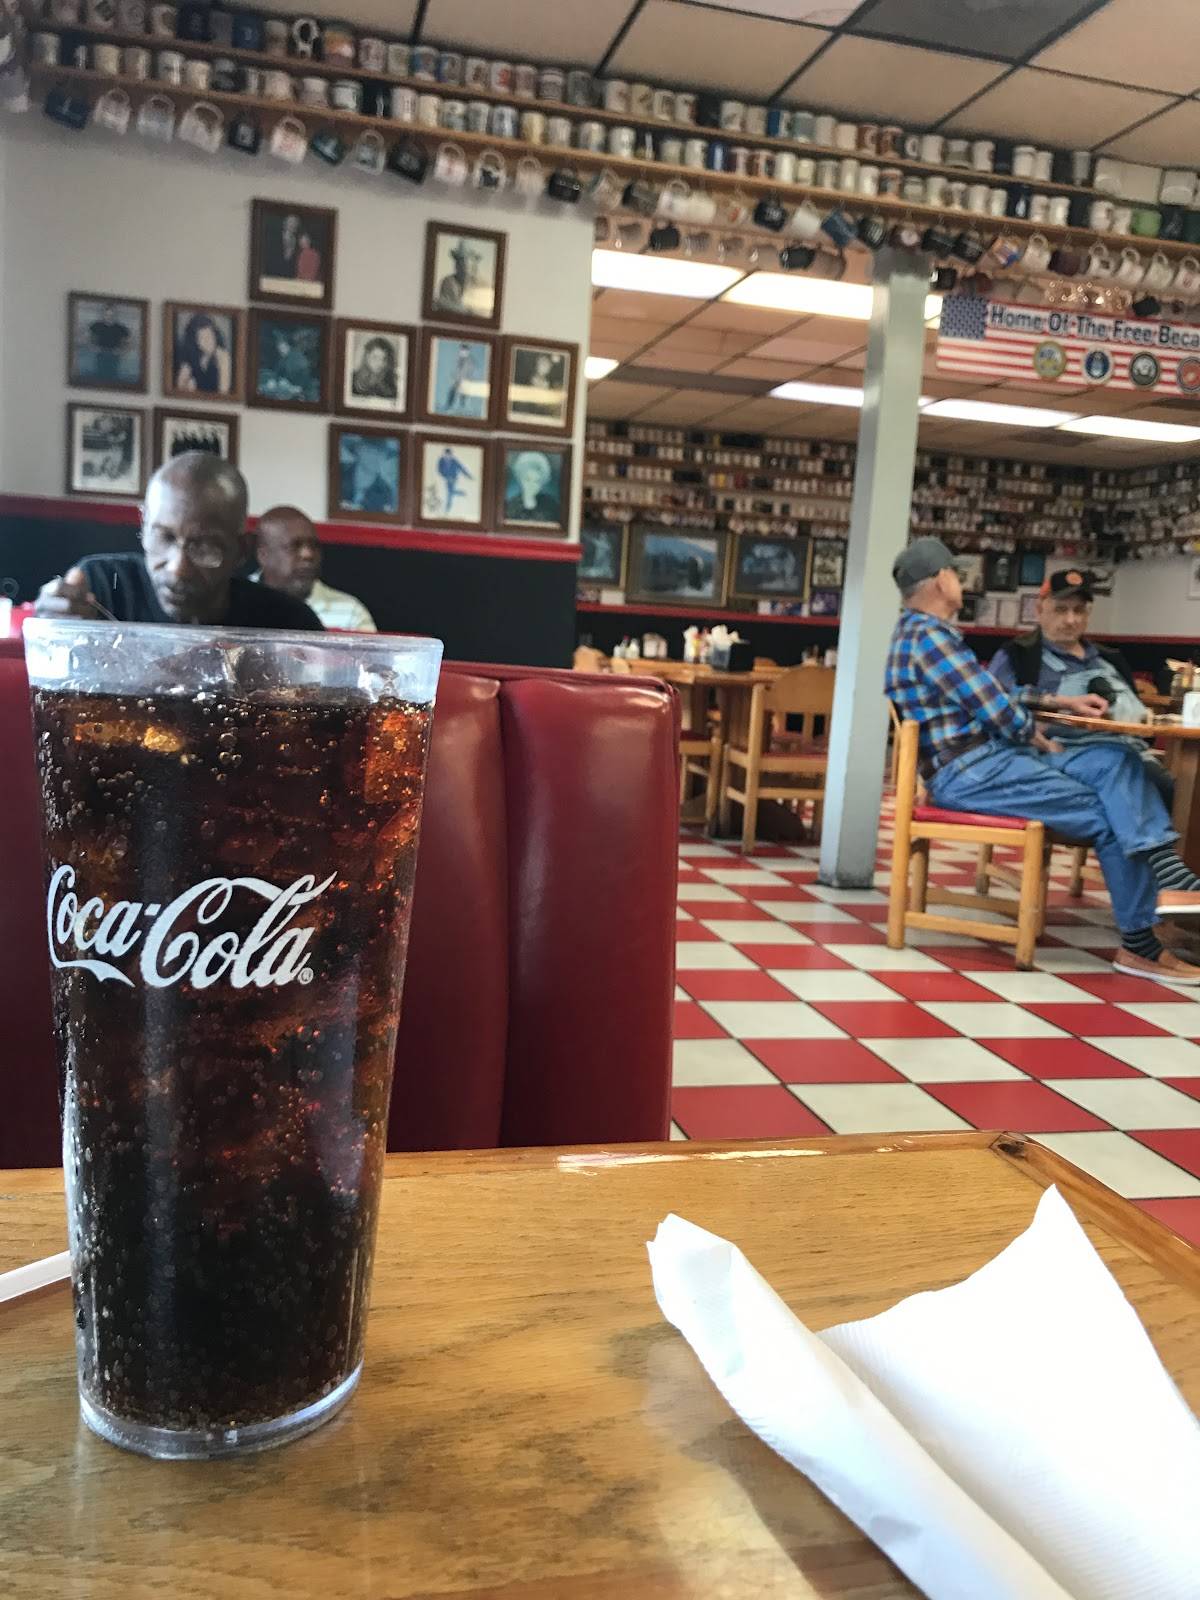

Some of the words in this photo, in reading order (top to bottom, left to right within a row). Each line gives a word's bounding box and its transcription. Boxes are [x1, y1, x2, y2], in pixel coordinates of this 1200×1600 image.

[990, 305, 1043, 330] Home
[1048, 312, 1070, 333] Of
[1076, 315, 1106, 337] The
[1112, 319, 1152, 342] Free
[47, 864, 337, 989] Coca-Cola
